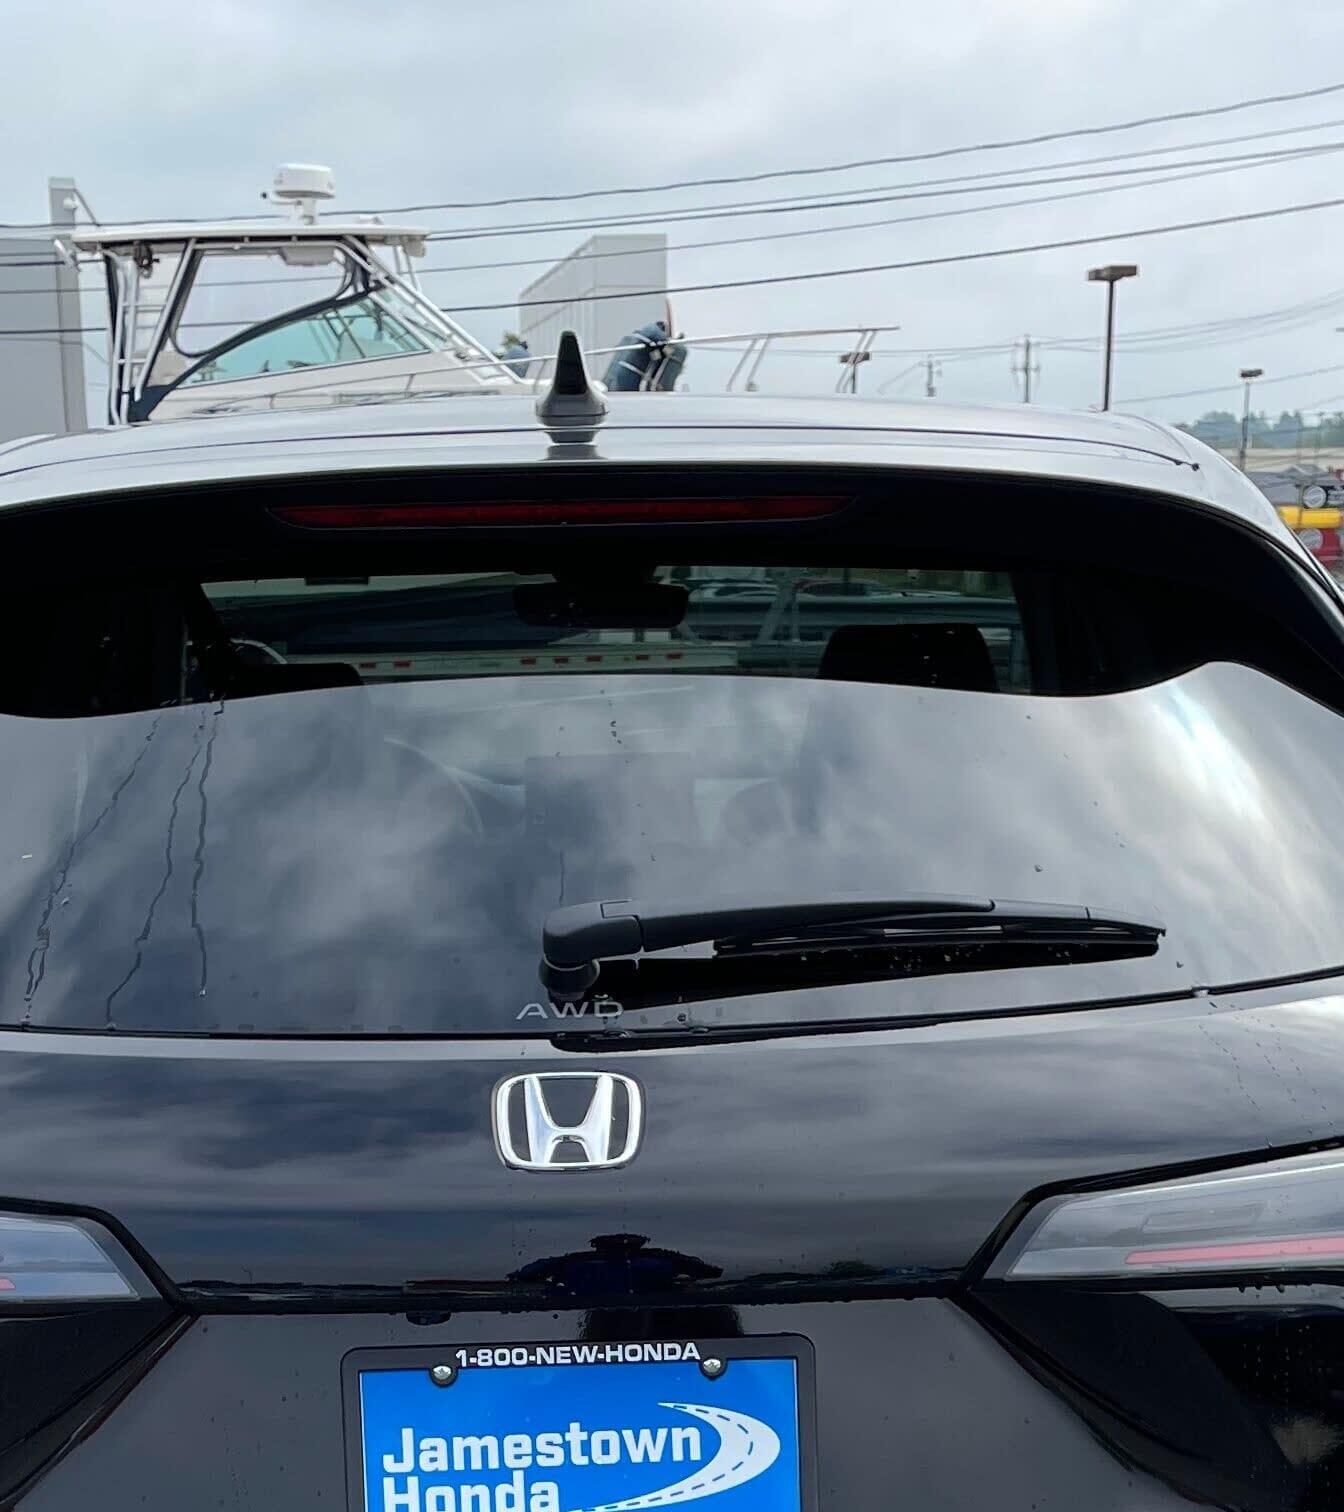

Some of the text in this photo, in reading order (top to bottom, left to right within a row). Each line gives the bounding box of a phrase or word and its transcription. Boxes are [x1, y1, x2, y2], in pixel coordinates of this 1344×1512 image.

[515, 1001, 625, 1021] AWD
[455, 1341, 701, 1369] 1-800-NEW-HONDA
[382, 1421, 702, 1474] Jamestown
